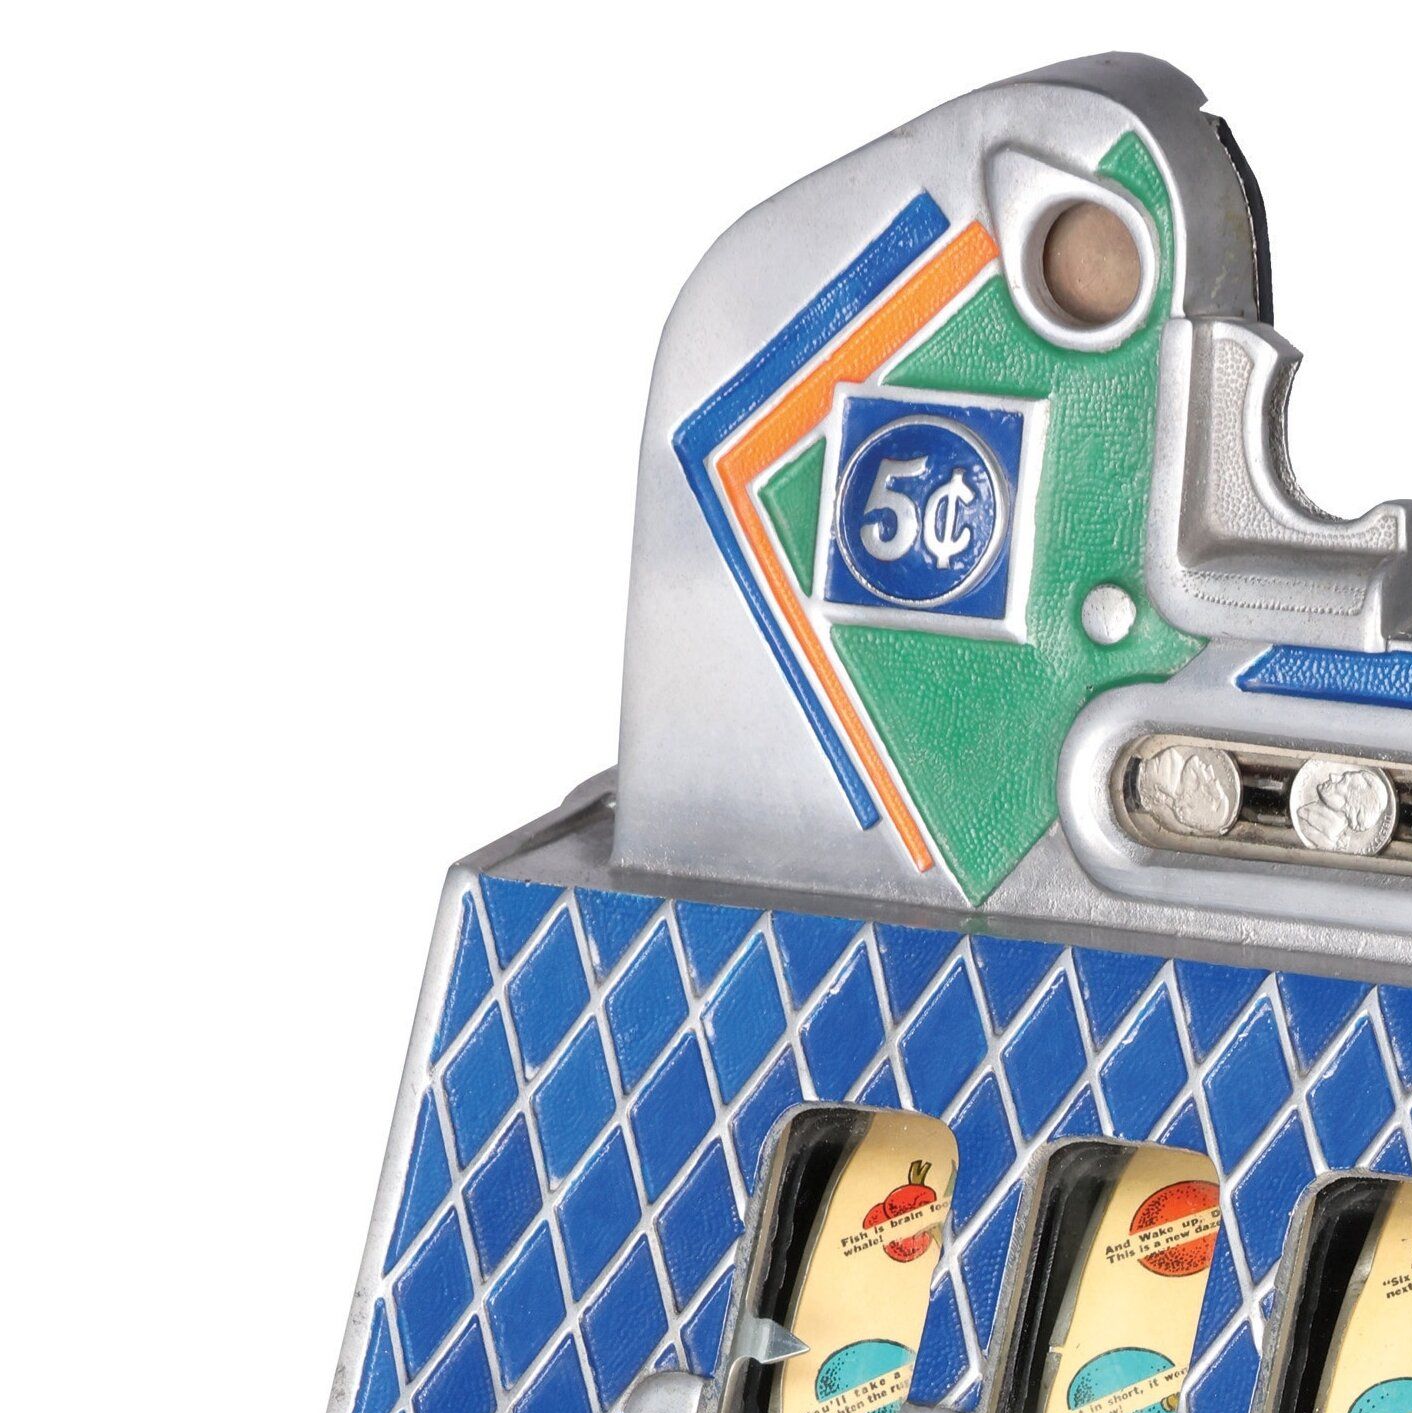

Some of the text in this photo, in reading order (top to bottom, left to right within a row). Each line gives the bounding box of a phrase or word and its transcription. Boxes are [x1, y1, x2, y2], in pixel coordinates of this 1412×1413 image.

[860, 455, 976, 569] 5¢
[841, 1210, 923, 1247] Fish is brain
[1105, 1226, 1173, 1256] And Wake
[843, 1235, 883, 1257] whale!
[1106, 1252, 1135, 1264] This
[1140, 1244, 1150, 1253] is
[1166, 1230, 1190, 1243] new
[854, 1378, 886, 1397] take
[894, 1371, 900, 1379] a
[867, 1390, 887, 1404] the
[1090, 1403, 1102, 1413] in
[1108, 1386, 1144, 1406] short,
[1149, 1380, 1159, 1388] it
